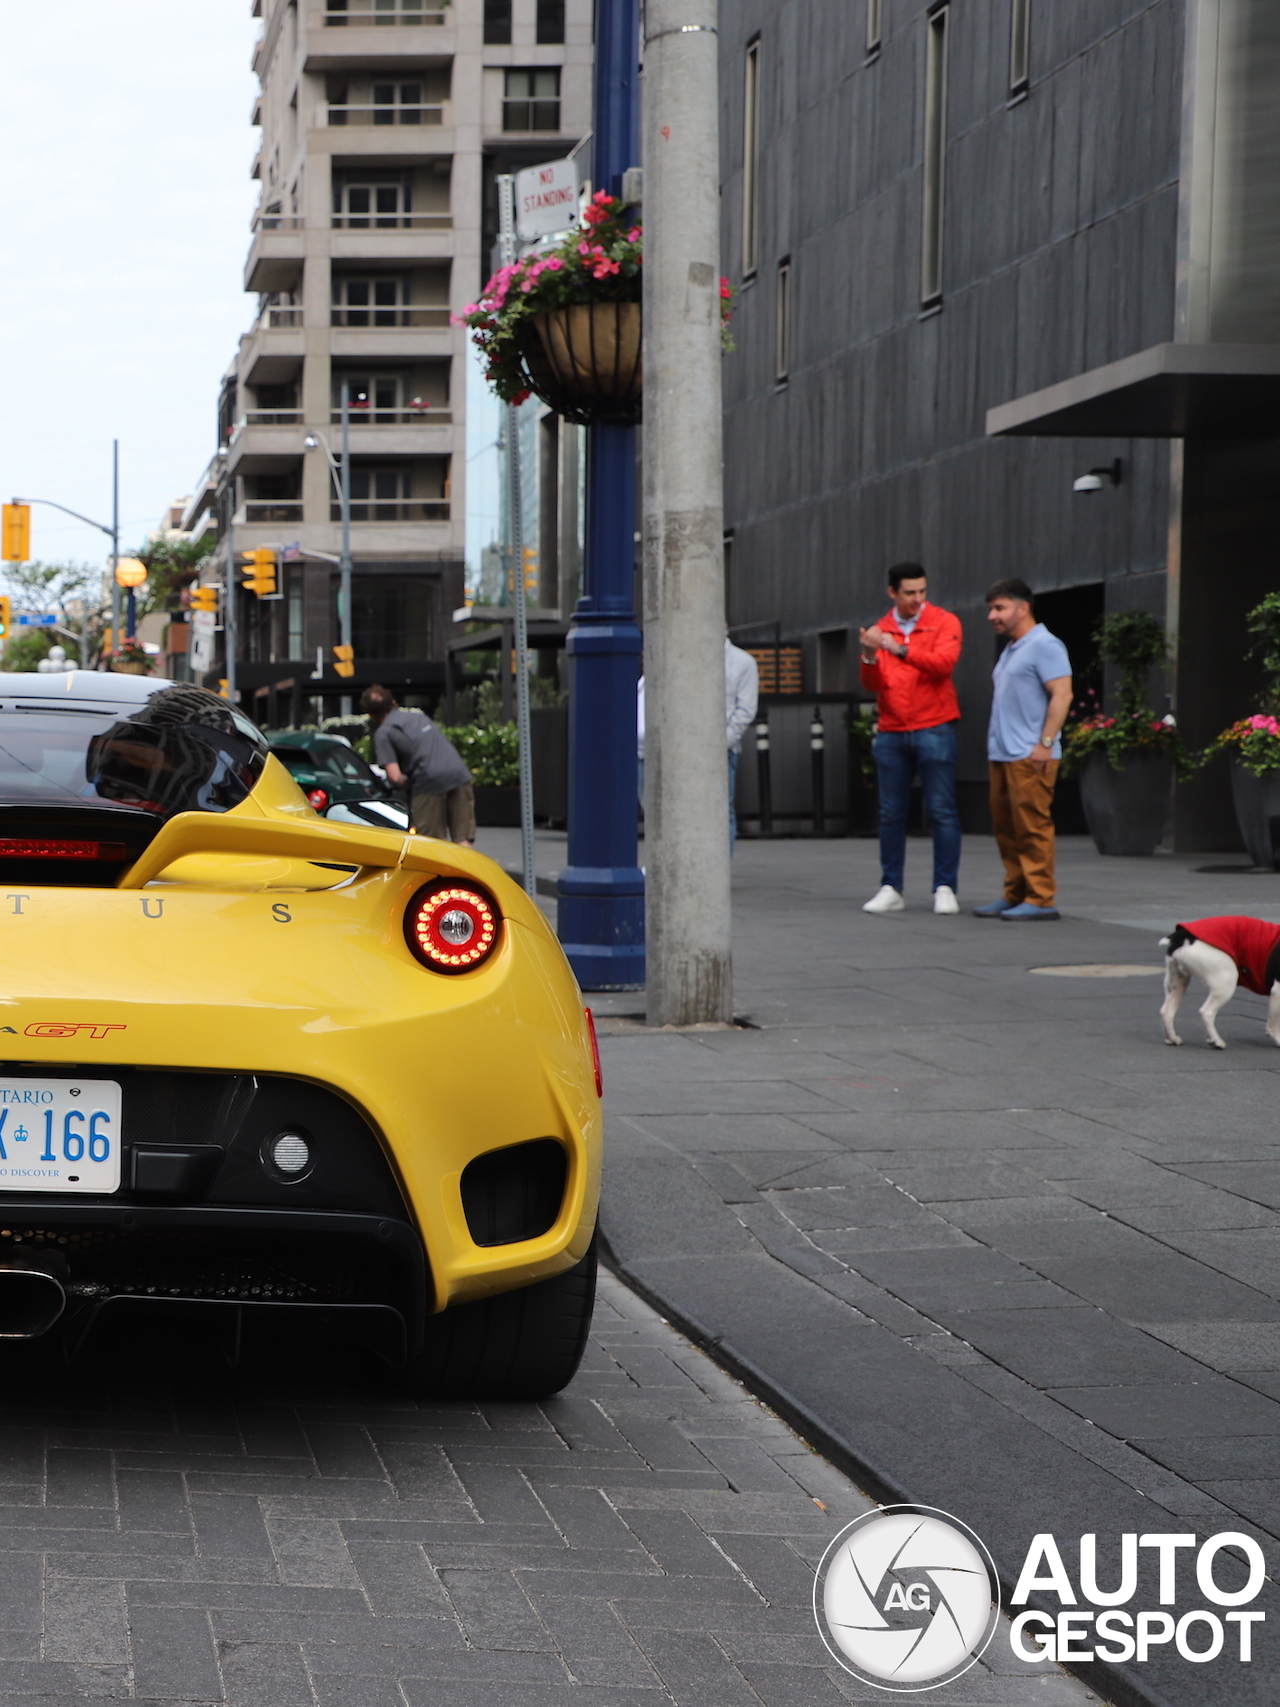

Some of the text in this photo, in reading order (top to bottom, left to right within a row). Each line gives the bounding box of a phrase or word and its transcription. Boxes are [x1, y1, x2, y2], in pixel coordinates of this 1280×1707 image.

[539, 167, 554, 185] NO
[523, 186, 574, 213] STANDING
[23, 1022, 128, 1039] GT
[40, 1108, 111, 1163] 166
[10, 1168, 60, 1178] DISCOVER
